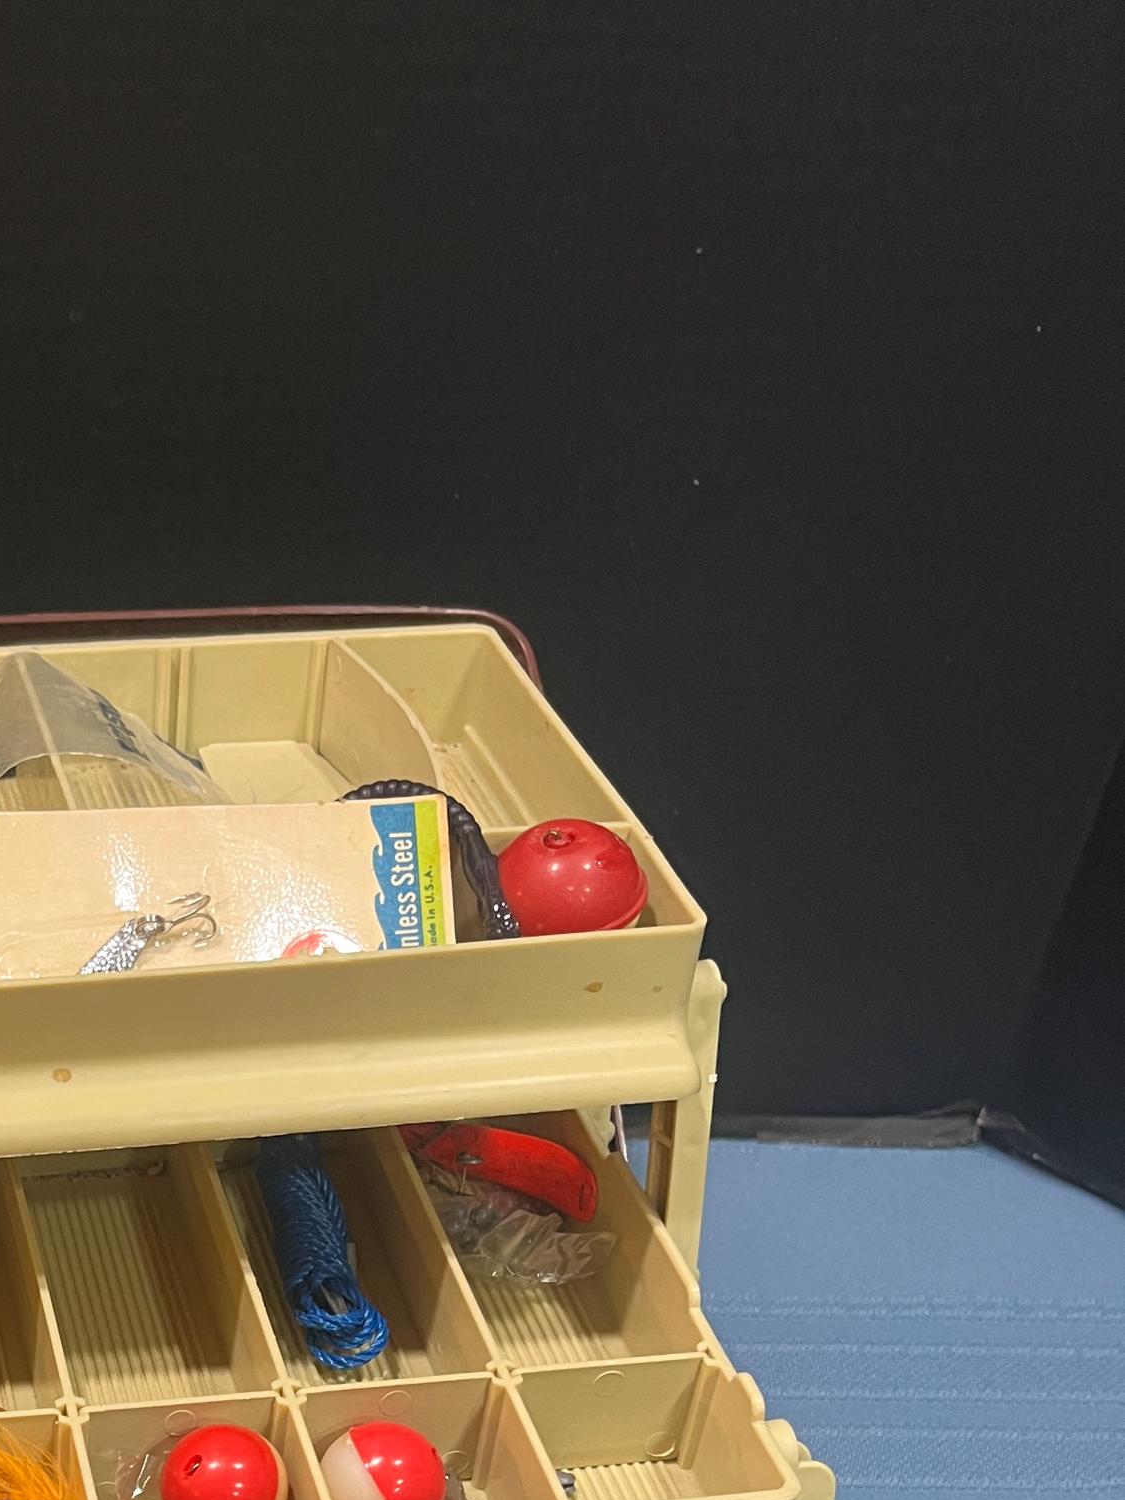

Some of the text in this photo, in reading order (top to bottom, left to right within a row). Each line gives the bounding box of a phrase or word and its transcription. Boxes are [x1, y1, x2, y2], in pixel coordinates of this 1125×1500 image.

[388, 832, 420, 948] nless Steel
[424, 865, 436, 904] U.S.A.
[427, 923, 438, 947] ade
